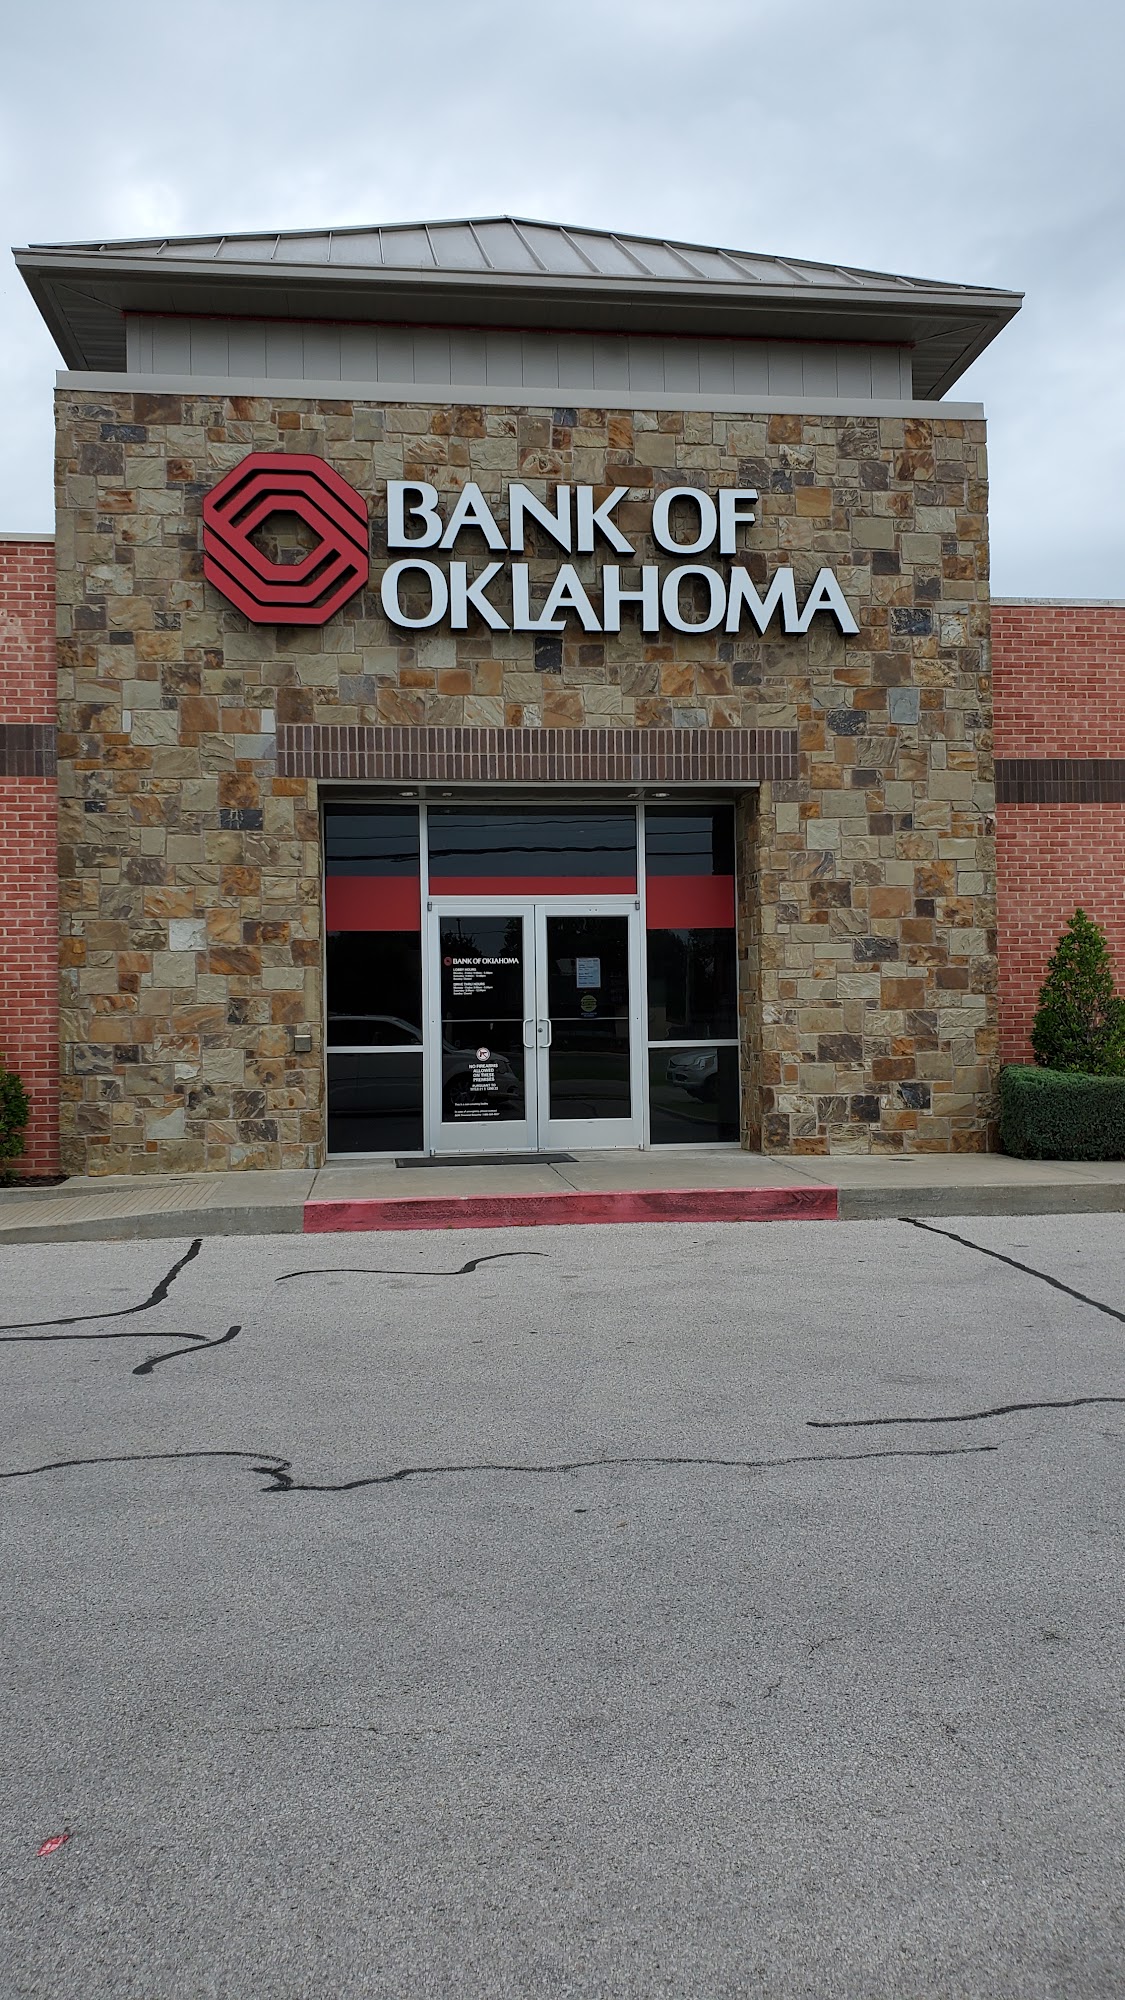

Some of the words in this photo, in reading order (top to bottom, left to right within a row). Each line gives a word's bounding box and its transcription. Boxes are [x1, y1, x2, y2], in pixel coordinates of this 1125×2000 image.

[386, 480, 635, 555] BANK
[651, 486, 759, 555] OF
[381, 558, 860, 636] OKLAHOMA
[453, 957, 472, 965] BANK
[472, 957, 482, 965] OF
[482, 957, 519, 965] OKLAHOMA
